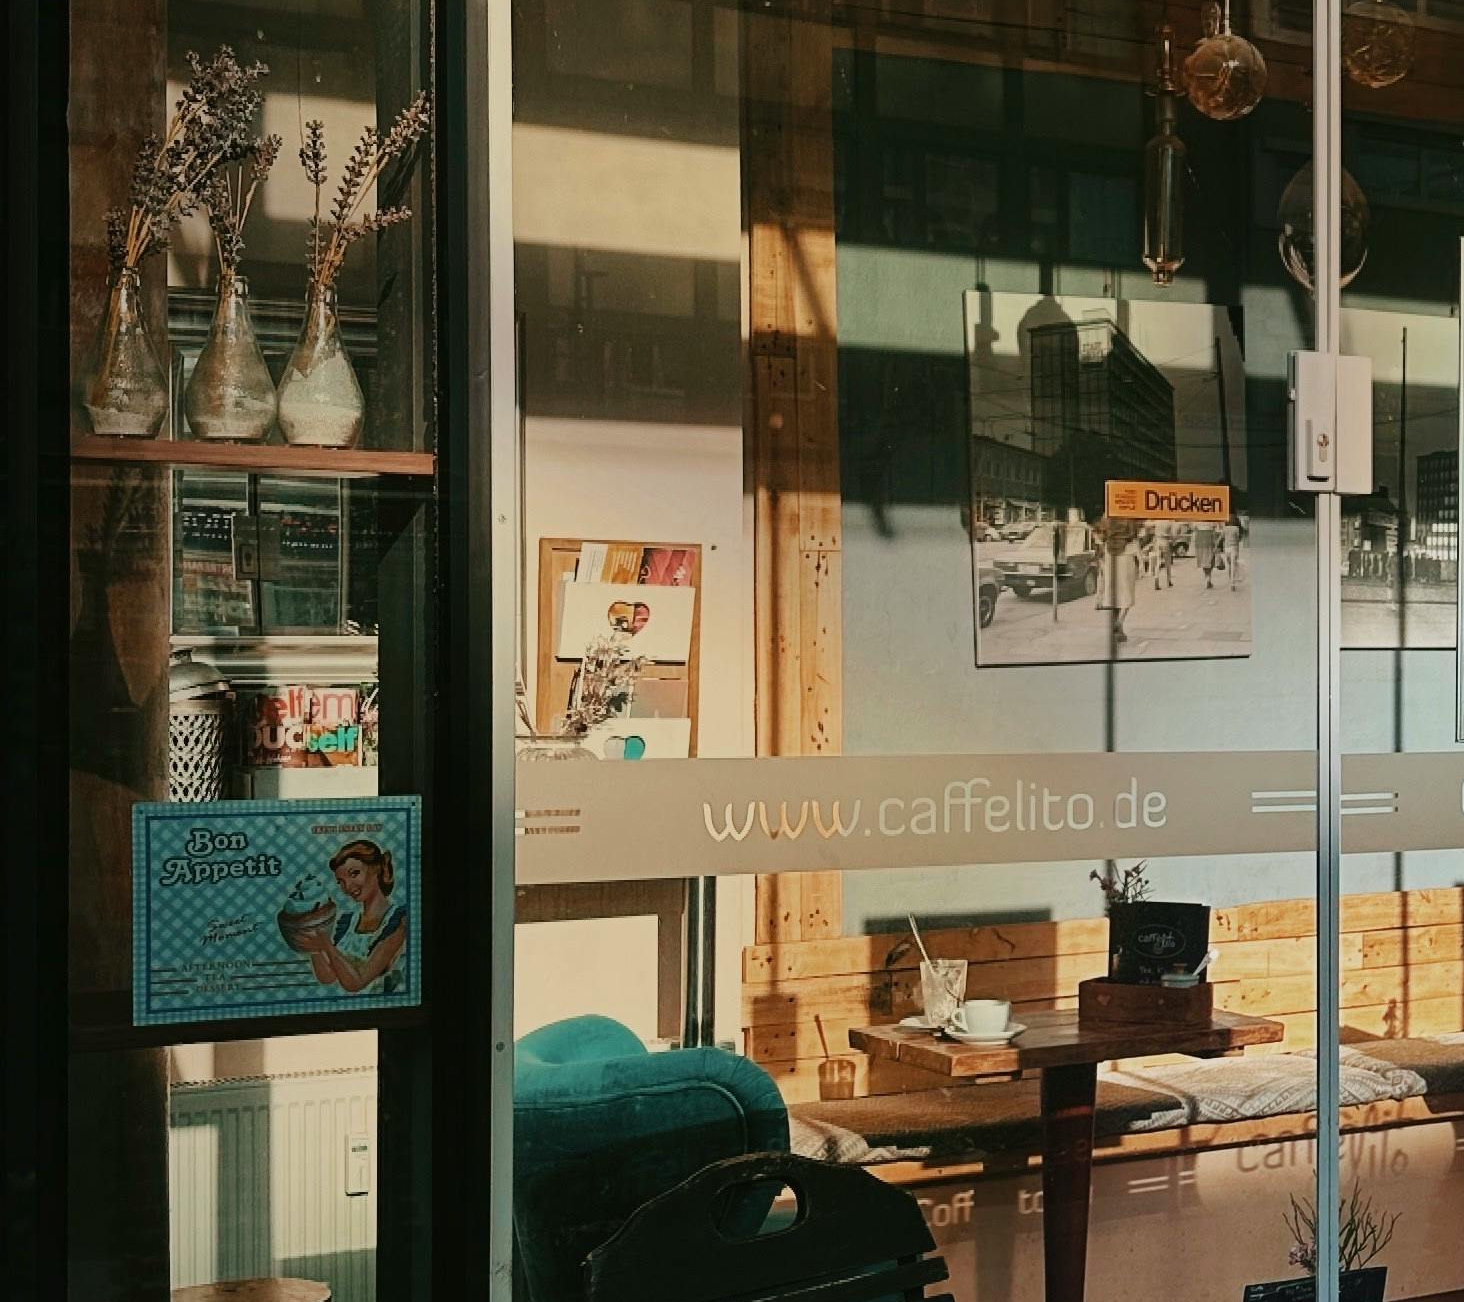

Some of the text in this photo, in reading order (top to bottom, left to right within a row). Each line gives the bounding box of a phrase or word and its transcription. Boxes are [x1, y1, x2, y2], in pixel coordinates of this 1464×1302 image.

[1144, 489, 1224, 512] Drücken
[703, 776, 1167, 844] www.caffelito.de
[185, 827, 249, 856] Bon
[160, 854, 282, 886] Appetit
